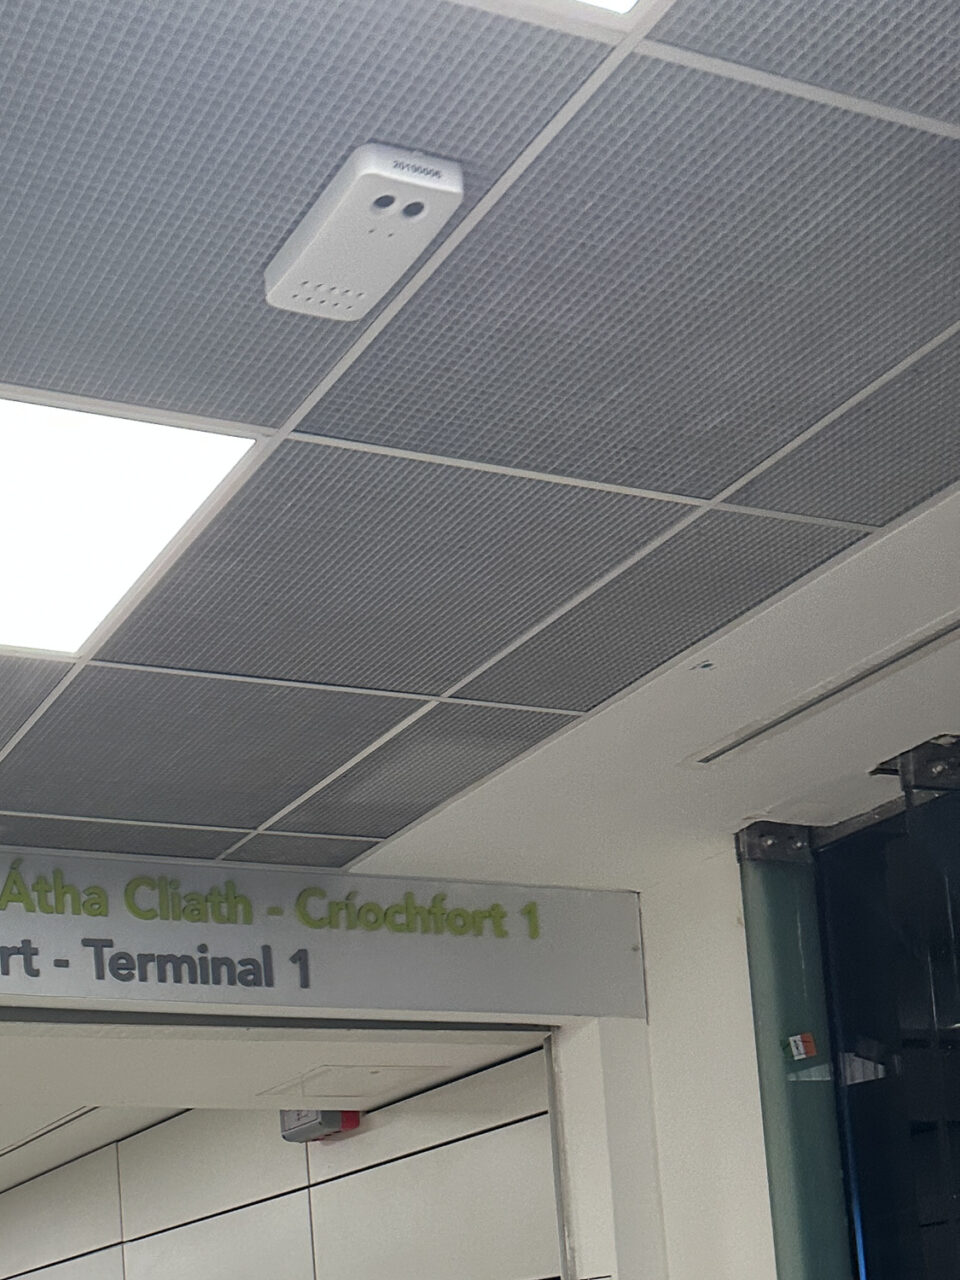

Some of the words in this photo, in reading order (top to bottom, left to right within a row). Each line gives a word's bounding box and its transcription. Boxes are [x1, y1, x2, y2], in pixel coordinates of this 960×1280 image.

[124, 875, 253, 925] Cliath
[267, 906, 284, 916] -
[295, 886, 508, 938] Críochfort
[520, 902, 539, 940] 1
[54, 959, 69, 968] -
[81, 938, 275, 987] Terminal
[289, 948, 310, 988] 1
